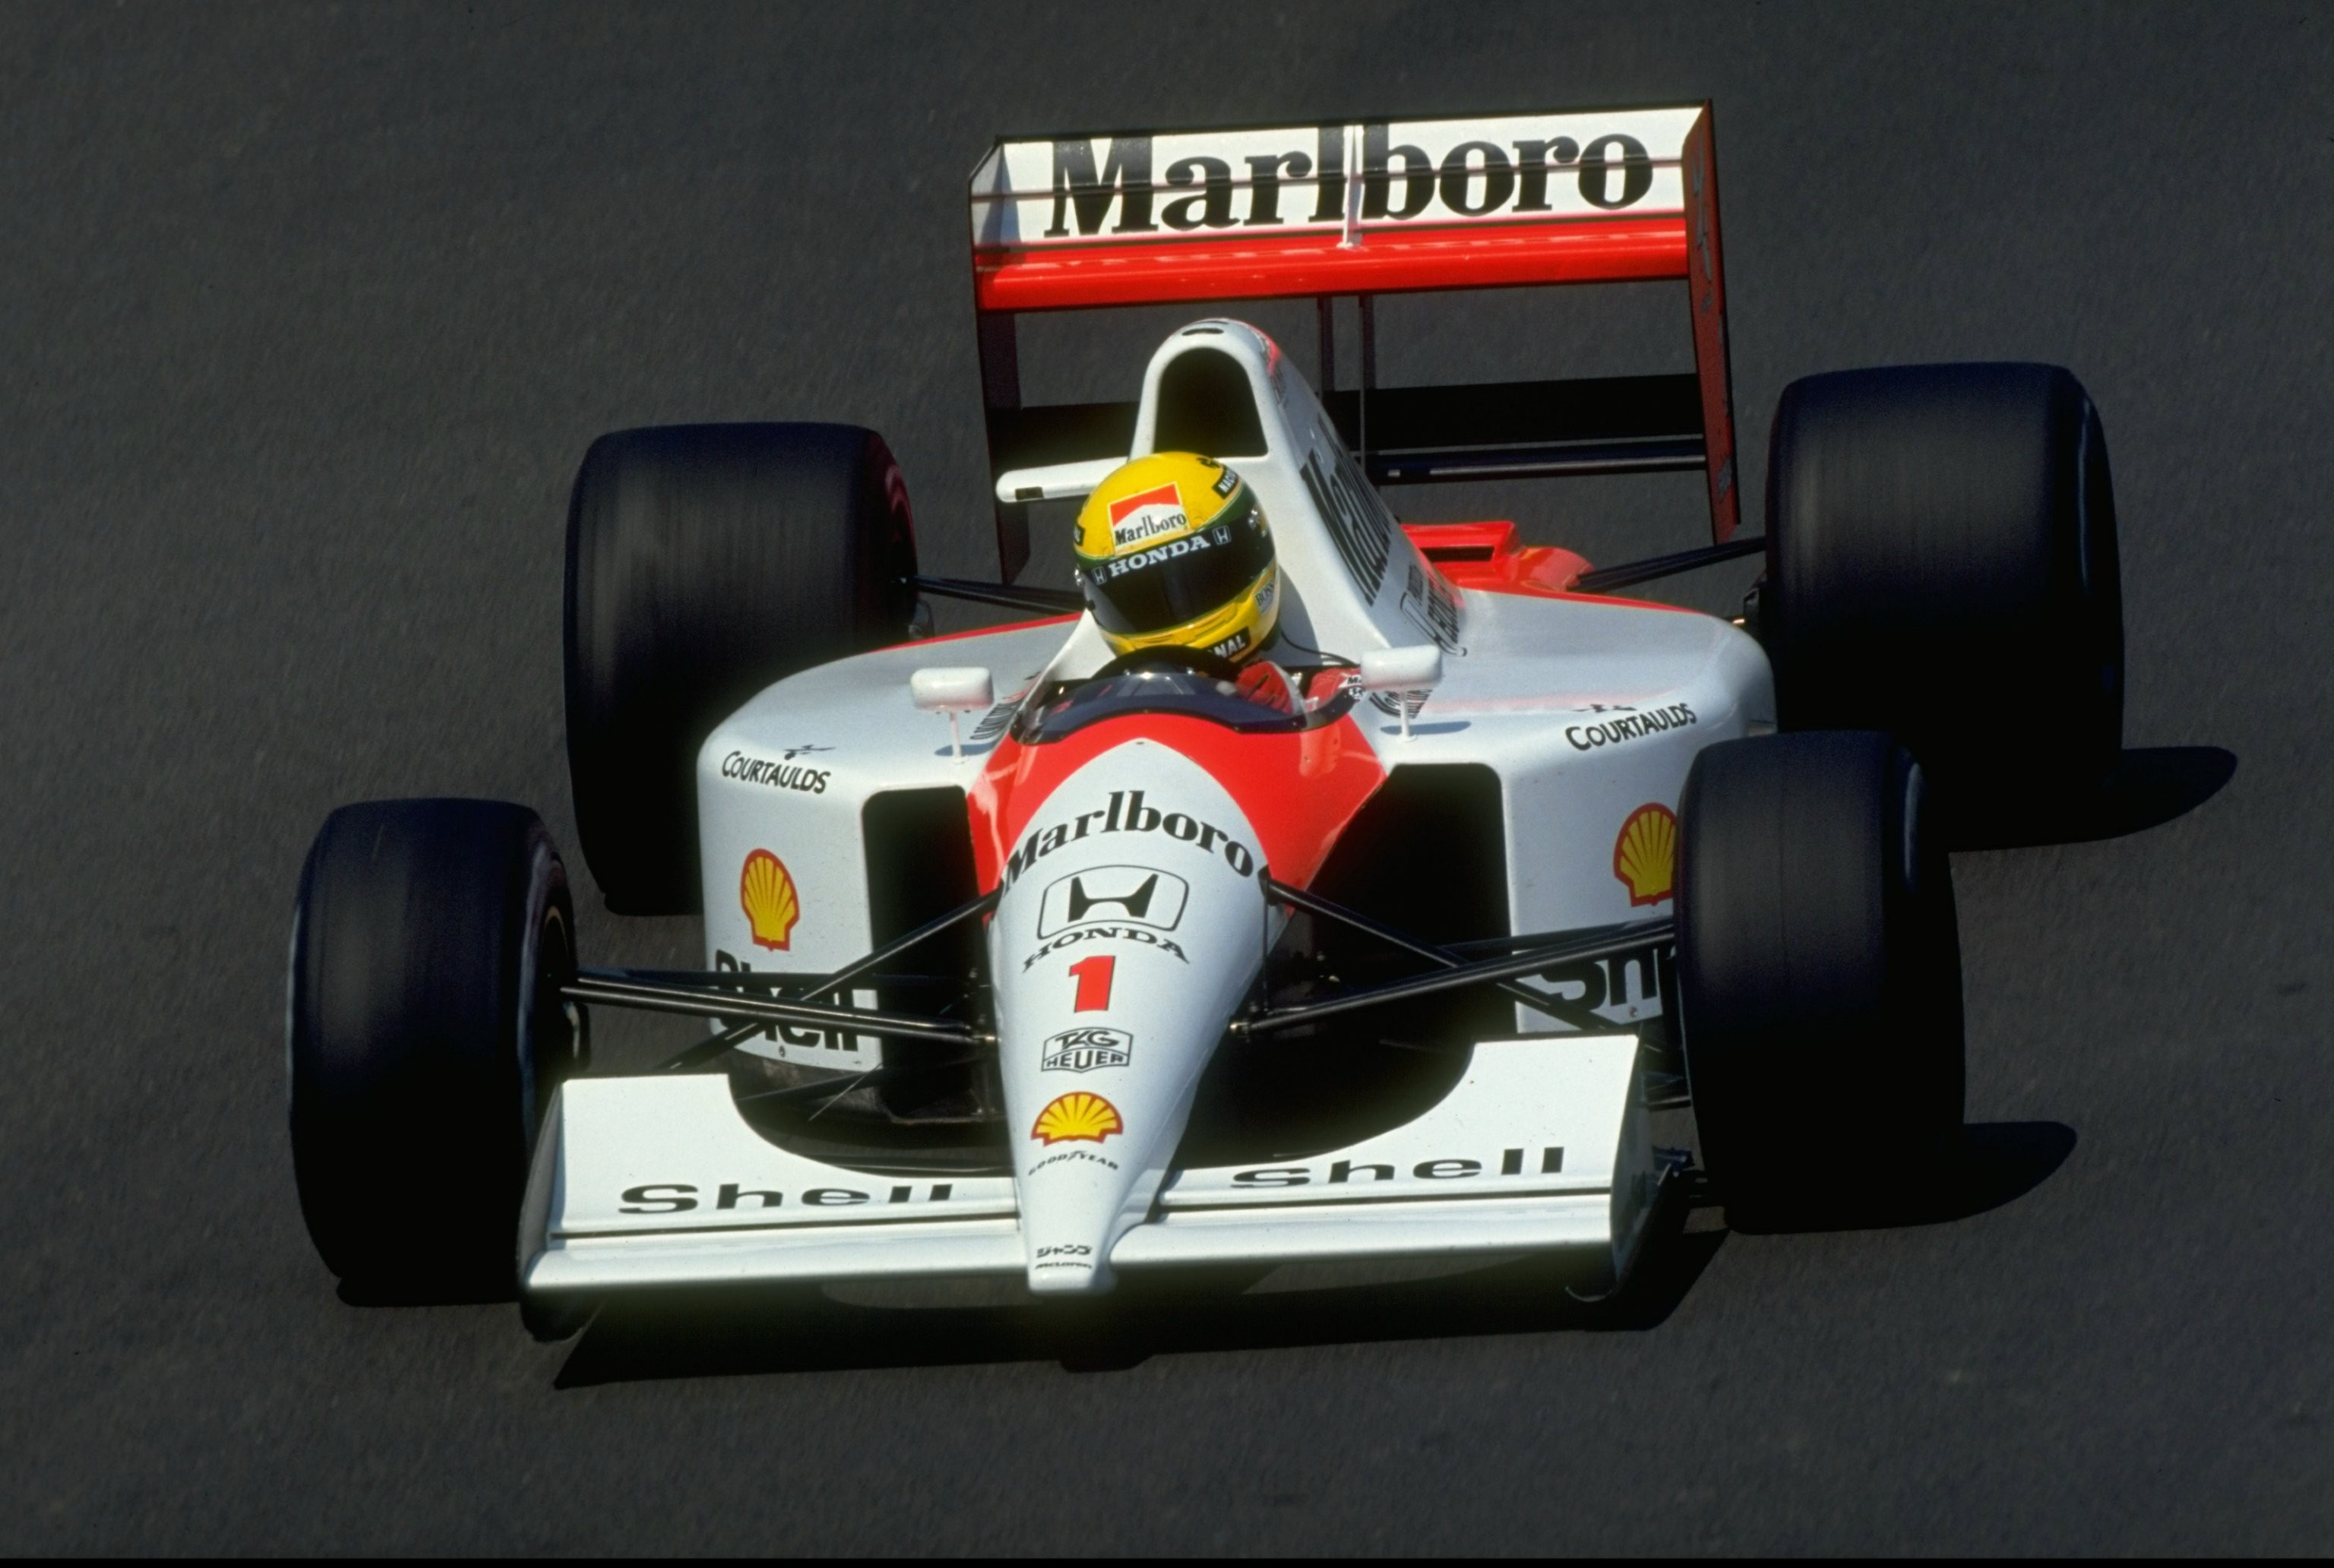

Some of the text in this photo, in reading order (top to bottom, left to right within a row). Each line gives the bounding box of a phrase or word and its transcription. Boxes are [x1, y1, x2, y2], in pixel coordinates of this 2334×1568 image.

[1043, 123, 1653, 237] Marlboro
[1114, 511, 1187, 547] Marlboro
[1110, 535, 1210, 577] HONDA
[1209, 634, 1246, 659] NAL
[1565, 703, 1697, 751] COURTAULDS
[722, 751, 831, 794] COURTAULDS
[1002, 790, 1254, 896] Marlboro
[1023, 927, 1190, 973] HONDA
[1068, 956, 1115, 1013] 1
[1046, 1049, 1125, 1070] HEUER
[1230, 1146, 1564, 1188] Shell
[618, 1183, 953, 1214] Shell
